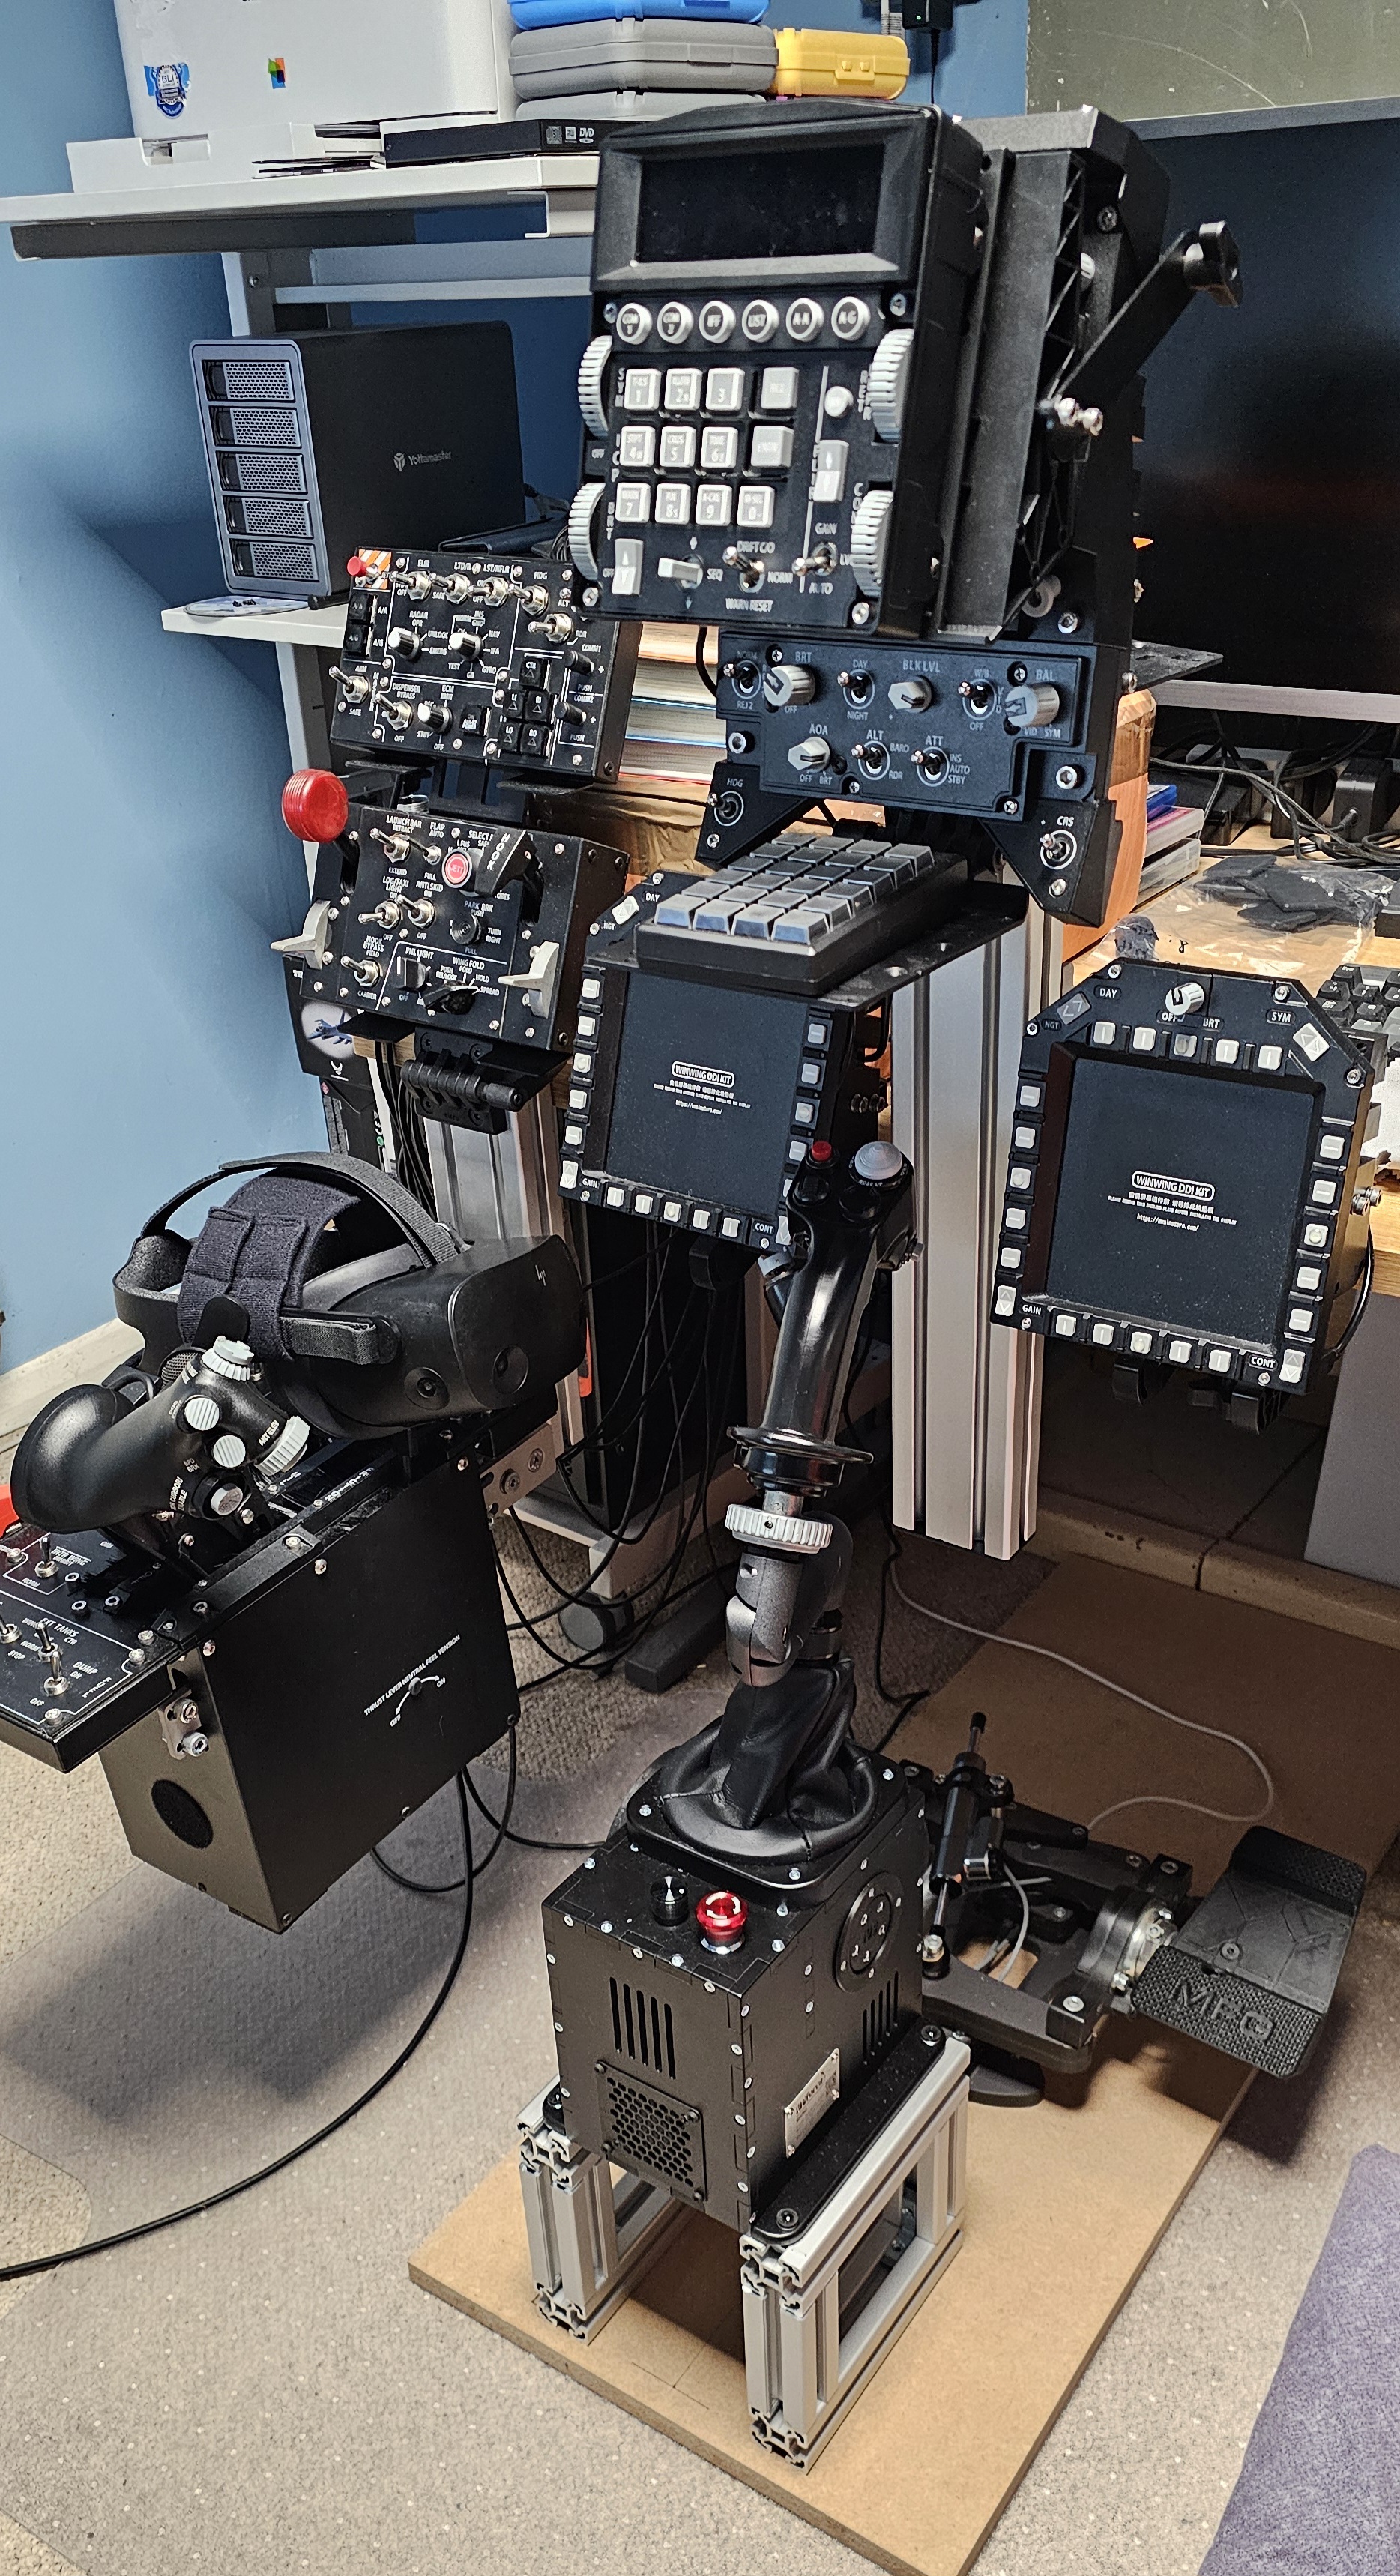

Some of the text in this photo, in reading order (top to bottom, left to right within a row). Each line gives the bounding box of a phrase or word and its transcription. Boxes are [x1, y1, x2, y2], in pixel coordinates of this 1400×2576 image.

[162, 74, 174, 83] BLI
[579, 127, 594, 137] DVD
[717, 387, 726, 402] 3
[625, 502, 635, 516] 7
[706, 504, 715, 519] 9
[795, 651, 812, 663] BRT
[853, 660, 869, 668] DAY
[903, 660, 940, 672] BLK LVL
[1036, 669, 1054, 681] BAL
[848, 711, 869, 720] NIGHT
[809, 724, 828, 735] AOA
[866, 730, 884, 740] ALT
[1025, 727, 1061, 738] VID SYM
[926, 735, 944, 746] ATT
[950, 764, 970, 774] AUTO
[727, 778, 743, 788] HDG
[800, 775, 812, 783] OFF
[819, 776, 832, 785] BRT
[948, 776, 965, 785] STBY
[1057, 816, 1075, 827] CRS
[645, 893, 660, 902] DAY
[464, 900, 480, 910] PARK
[1099, 989, 1117, 998] DAY
[1162, 1012, 1179, 1022] OFF
[1272, 1012, 1291, 1023] SYM
[1045, 1021, 1059, 1030] NGT
[1203, 1019, 1220, 1028] BRT
[675, 1064, 731, 1085] WINWING DDI KIT
[582, 1177, 598, 1189] GAIN
[1136, 1175, 1210, 1198] WINWING DDI KIT
[755, 1222, 774, 1234] CONT
[1023, 1304, 1042, 1315] GAIN
[1251, 1355, 1275, 1369] CONT
[73, 1661, 98, 1674] DUMP
[364, 1695, 385, 1716] THRUST
[385, 1682, 402, 1699] LEVER
[438, 1635, 461, 1655] TENSION
[437, 1677, 446, 1687] ON
[390, 1714, 401, 1727] OFF
